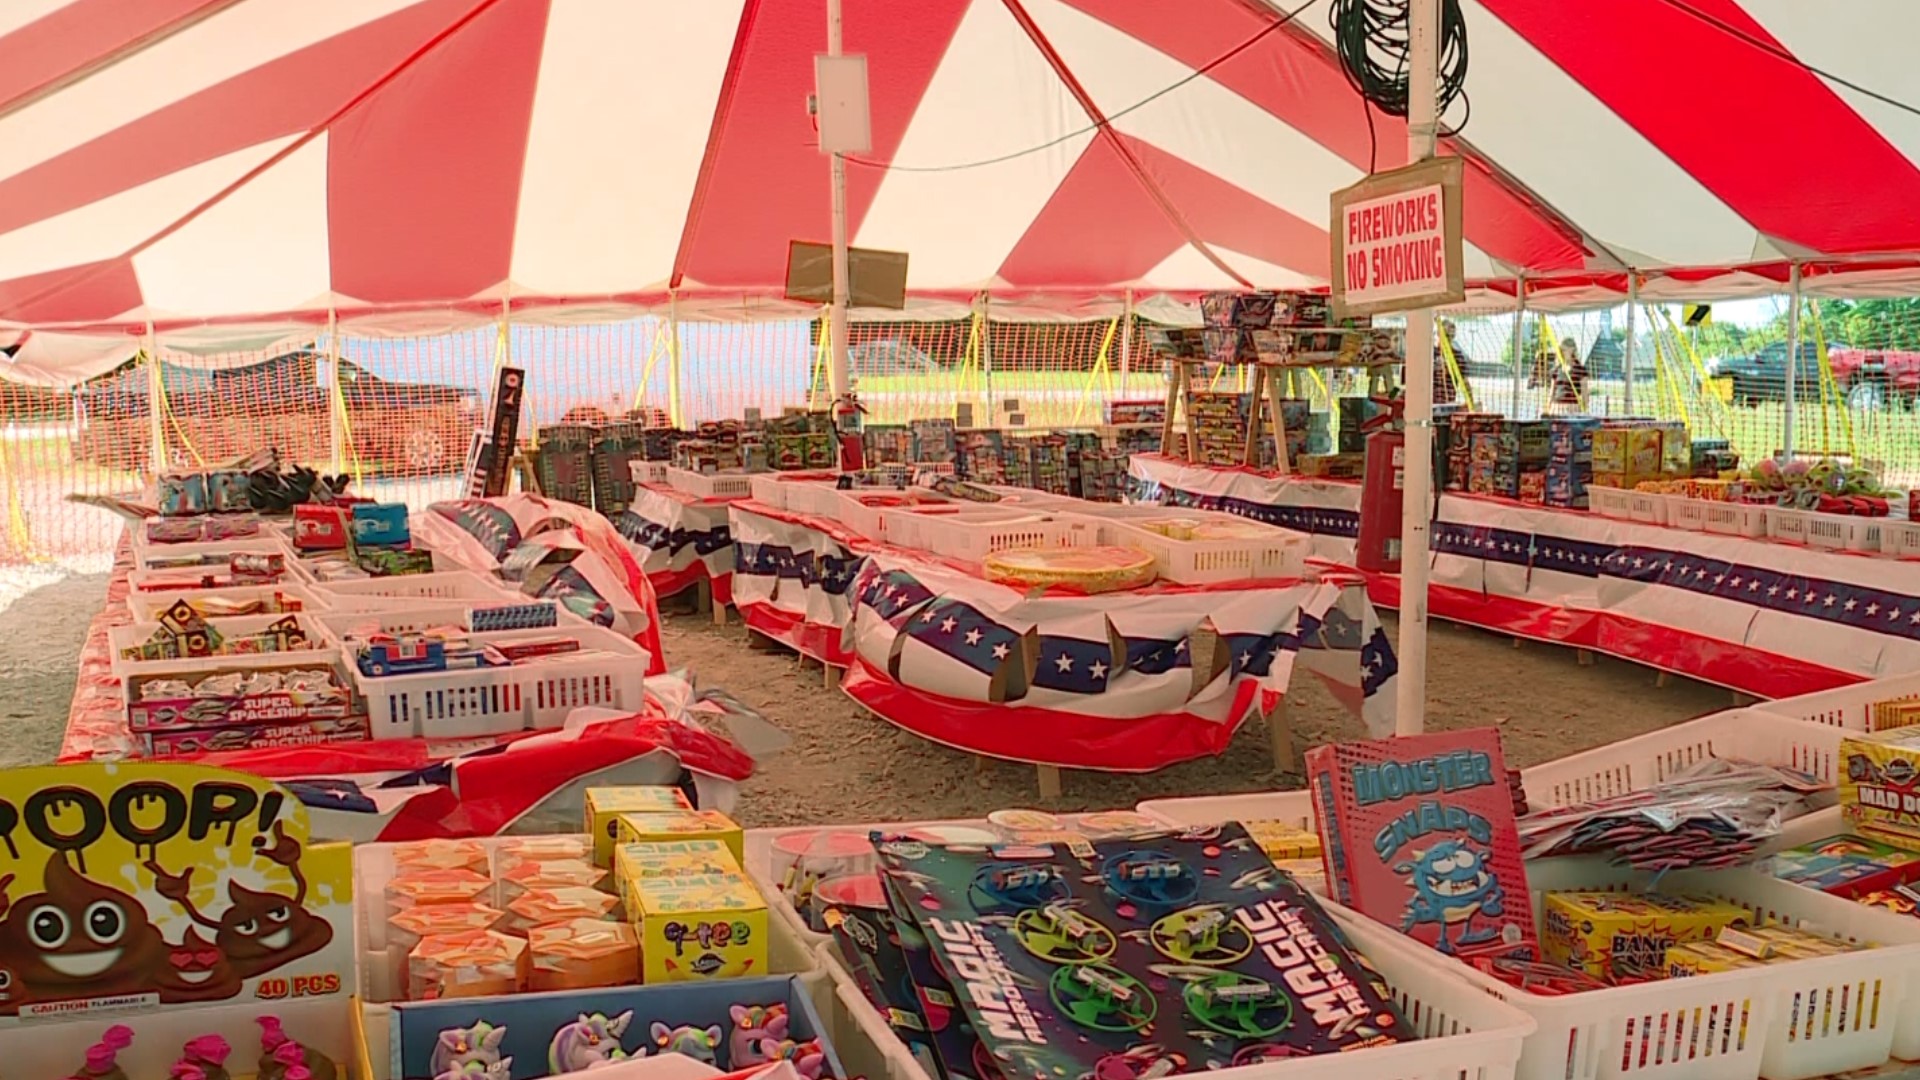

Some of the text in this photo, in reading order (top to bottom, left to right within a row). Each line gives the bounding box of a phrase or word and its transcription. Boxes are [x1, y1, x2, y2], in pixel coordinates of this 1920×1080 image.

[1348, 193, 1438, 245] FIREWORKS
[1347, 236, 1443, 291] NO SMOKING
[229, 707, 306, 722] SPACESHIP
[243, 696, 293, 710] SUPER
[265, 724, 312, 738] SUPER
[1352, 749, 1496, 806] MONSTER
[1859, 785, 1900, 810] MAD
[0, 780, 285, 862] OOP!
[1374, 801, 1493, 864] SNAPS
[1234, 902, 1349, 1026] MAGIC
[1266, 899, 1371, 1016] AEROCRAFT
[1611, 934, 1676, 954] BANG
[254, 978, 290, 999] 40
[929, 916, 1026, 1041] MAGIC
[31, 1000, 88, 1014] CAUTION
